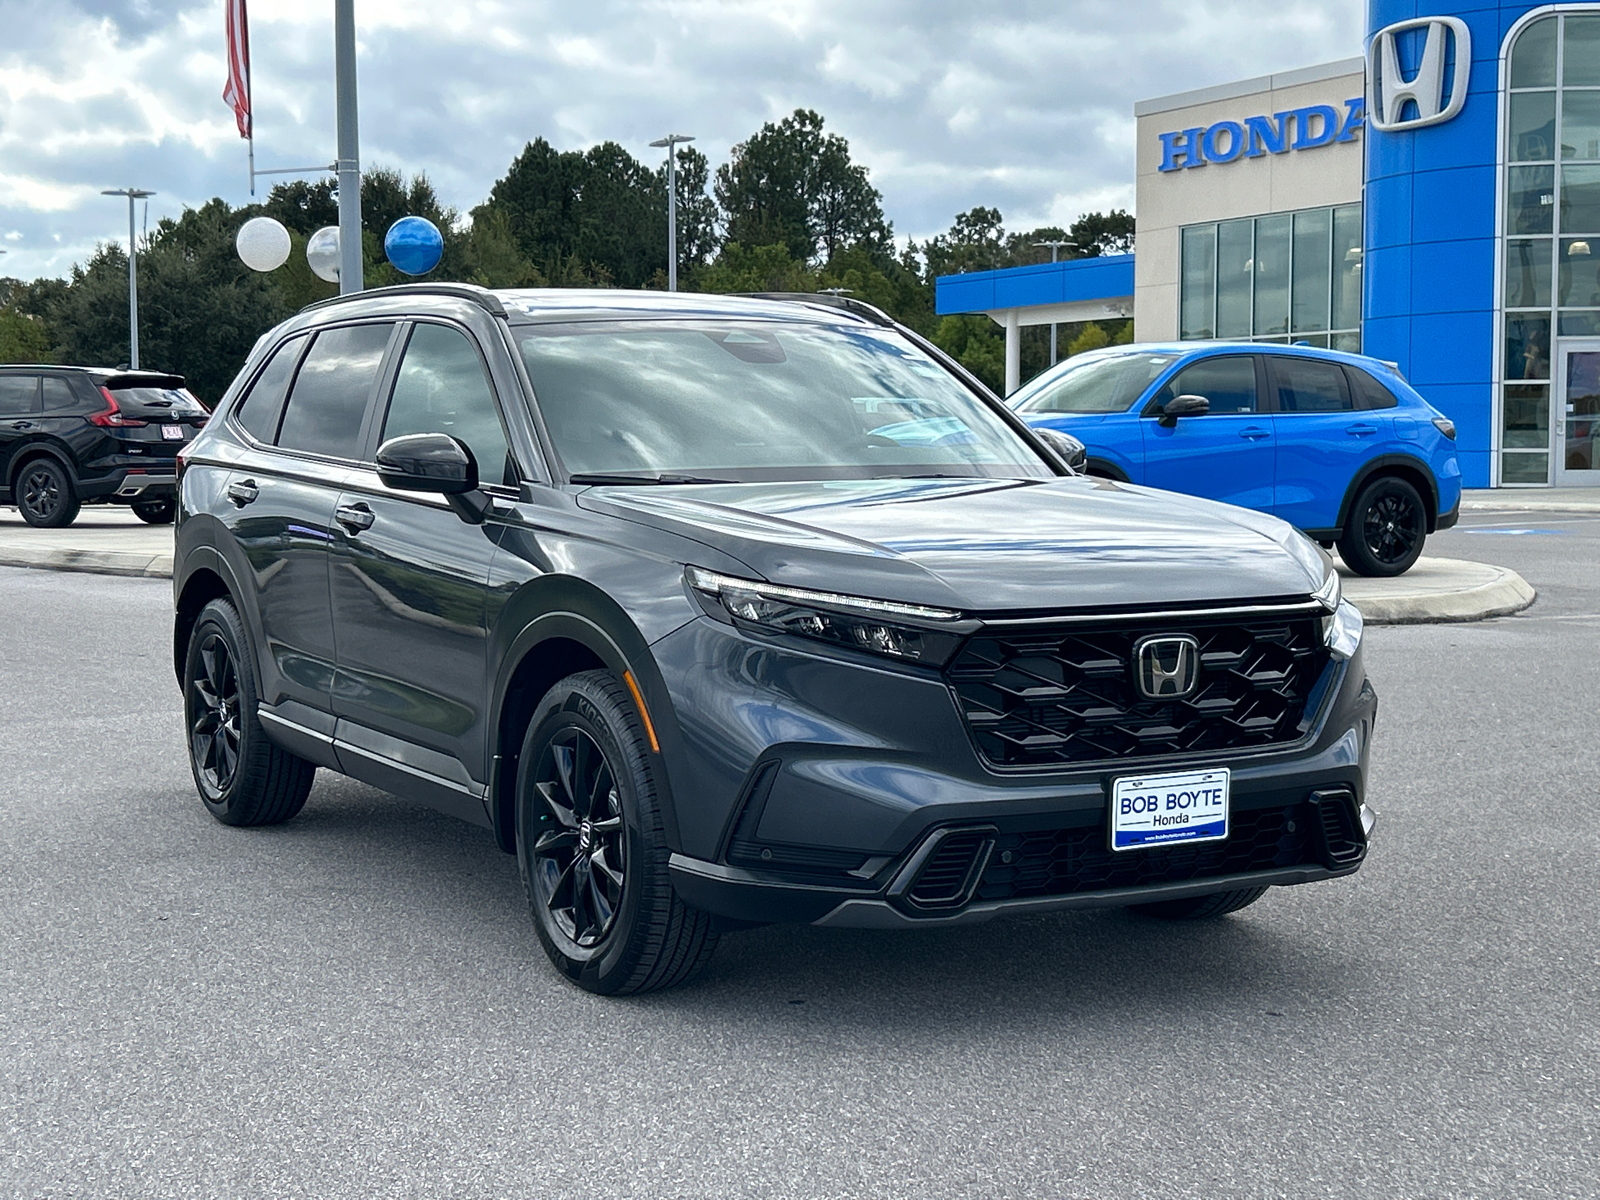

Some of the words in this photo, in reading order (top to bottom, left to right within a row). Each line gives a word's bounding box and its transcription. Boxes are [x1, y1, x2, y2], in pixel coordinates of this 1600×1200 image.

[1158, 97, 1364, 173] HONDA
[1121, 795, 1158, 815] BOB
[1166, 788, 1223, 810] BOYTE
[1153, 812, 1189, 826] Honda
